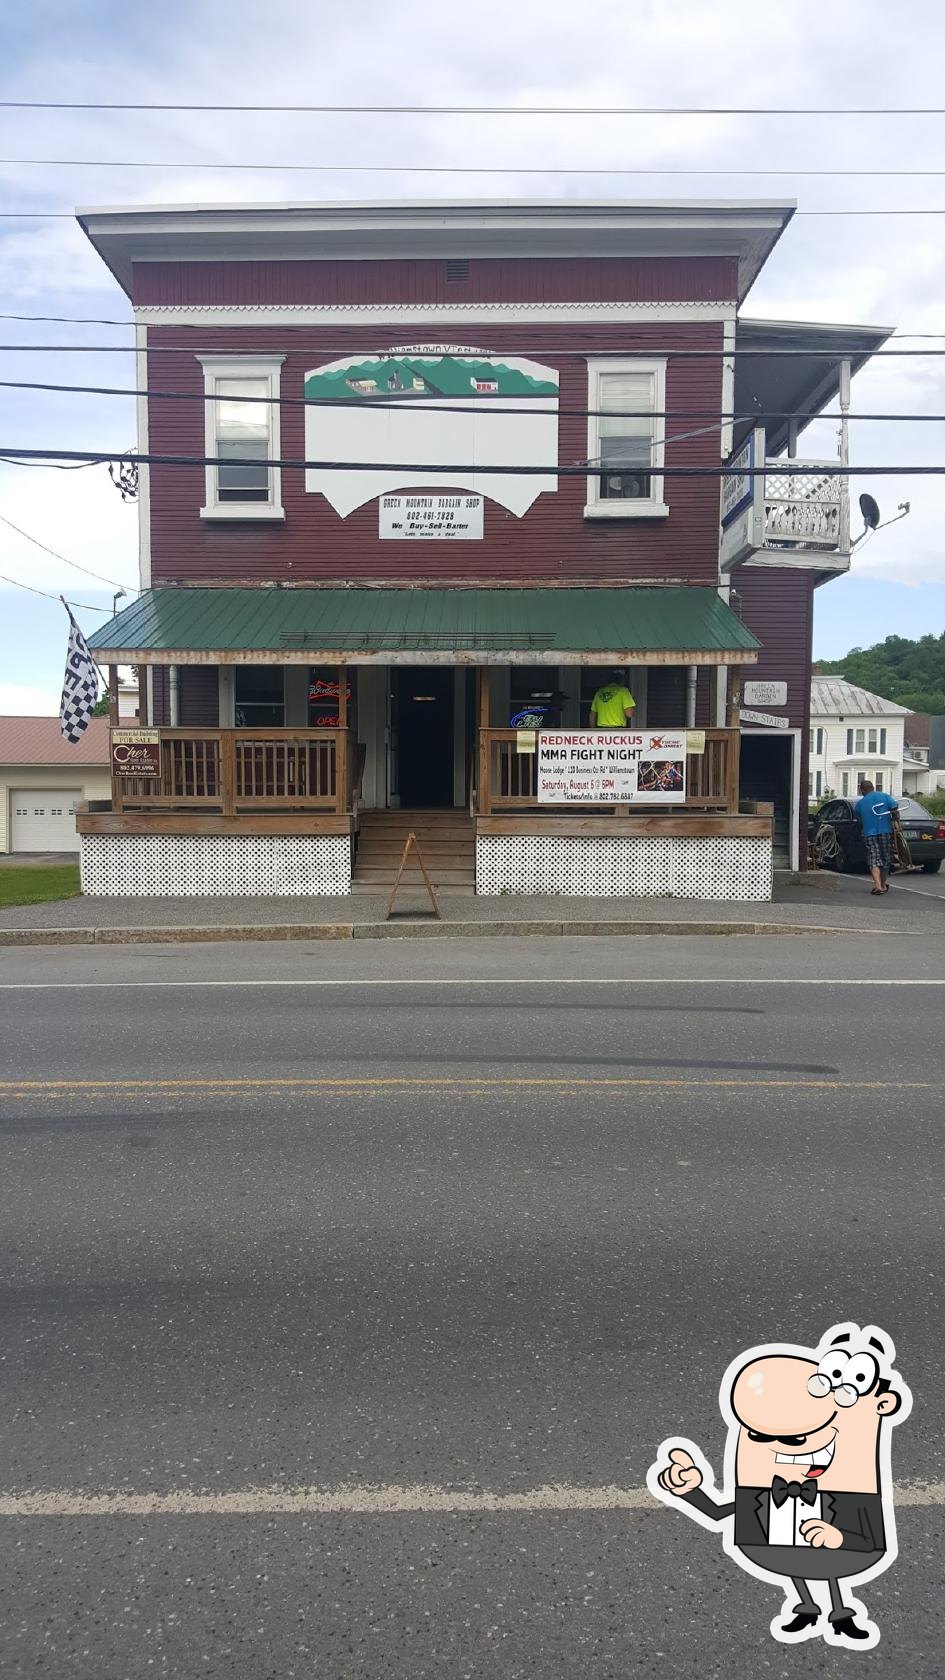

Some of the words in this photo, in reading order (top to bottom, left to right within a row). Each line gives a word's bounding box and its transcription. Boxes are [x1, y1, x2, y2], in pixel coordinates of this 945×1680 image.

[384, 498, 401, 508] GREEN
[406, 498, 433, 508] MOUNTAIN
[438, 498, 461, 508] BARGAIN
[466, 498, 480, 508] SHOP
[409, 522, 469, 531] Buy-Sell-Barter
[741, 710, 758, 721] DOWN
[761, 714, 786, 727] STAIRS
[540, 736, 594, 746] REDNECK
[597, 735, 643, 745] RUCKUS
[113, 744, 151, 763] Cher
[541, 750, 567, 760] MMA
[570, 750, 605, 760] FIGHT
[607, 749, 643, 760] NIGHT
[540, 766, 552, 774] Moose
[553, 766, 564, 775] Lodge
[576, 766, 592, 774] Business
[609, 766, 635, 774] Williamstown
[541, 779, 569, 792] Saturday,
[569, 779, 589, 792] August
[602, 779, 615, 789] 6PM
